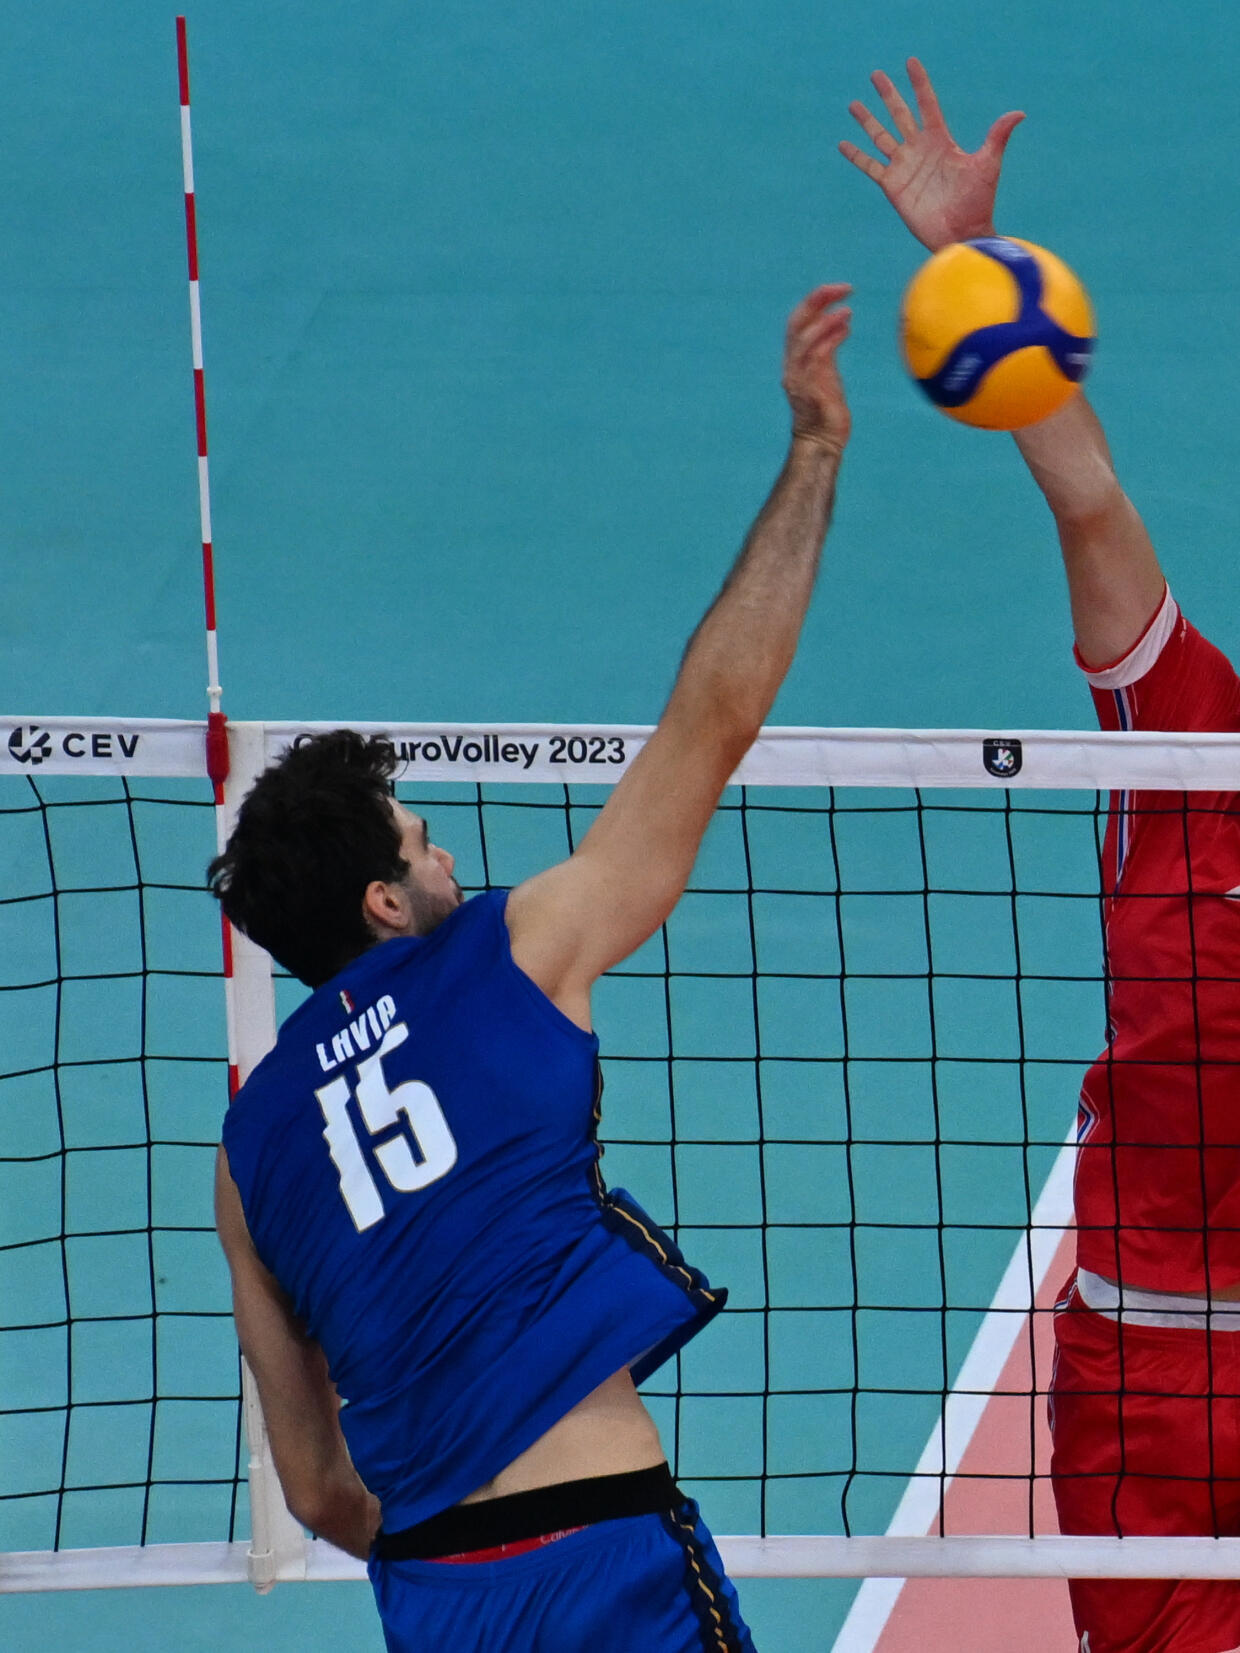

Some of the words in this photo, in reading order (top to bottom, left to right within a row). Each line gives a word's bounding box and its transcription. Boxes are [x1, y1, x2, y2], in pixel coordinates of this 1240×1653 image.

[62, 733, 140, 758] CEV
[391, 734, 539, 769] uroVolley
[549, 736, 626, 764] 2023
[314, 1021, 458, 1235] 15
